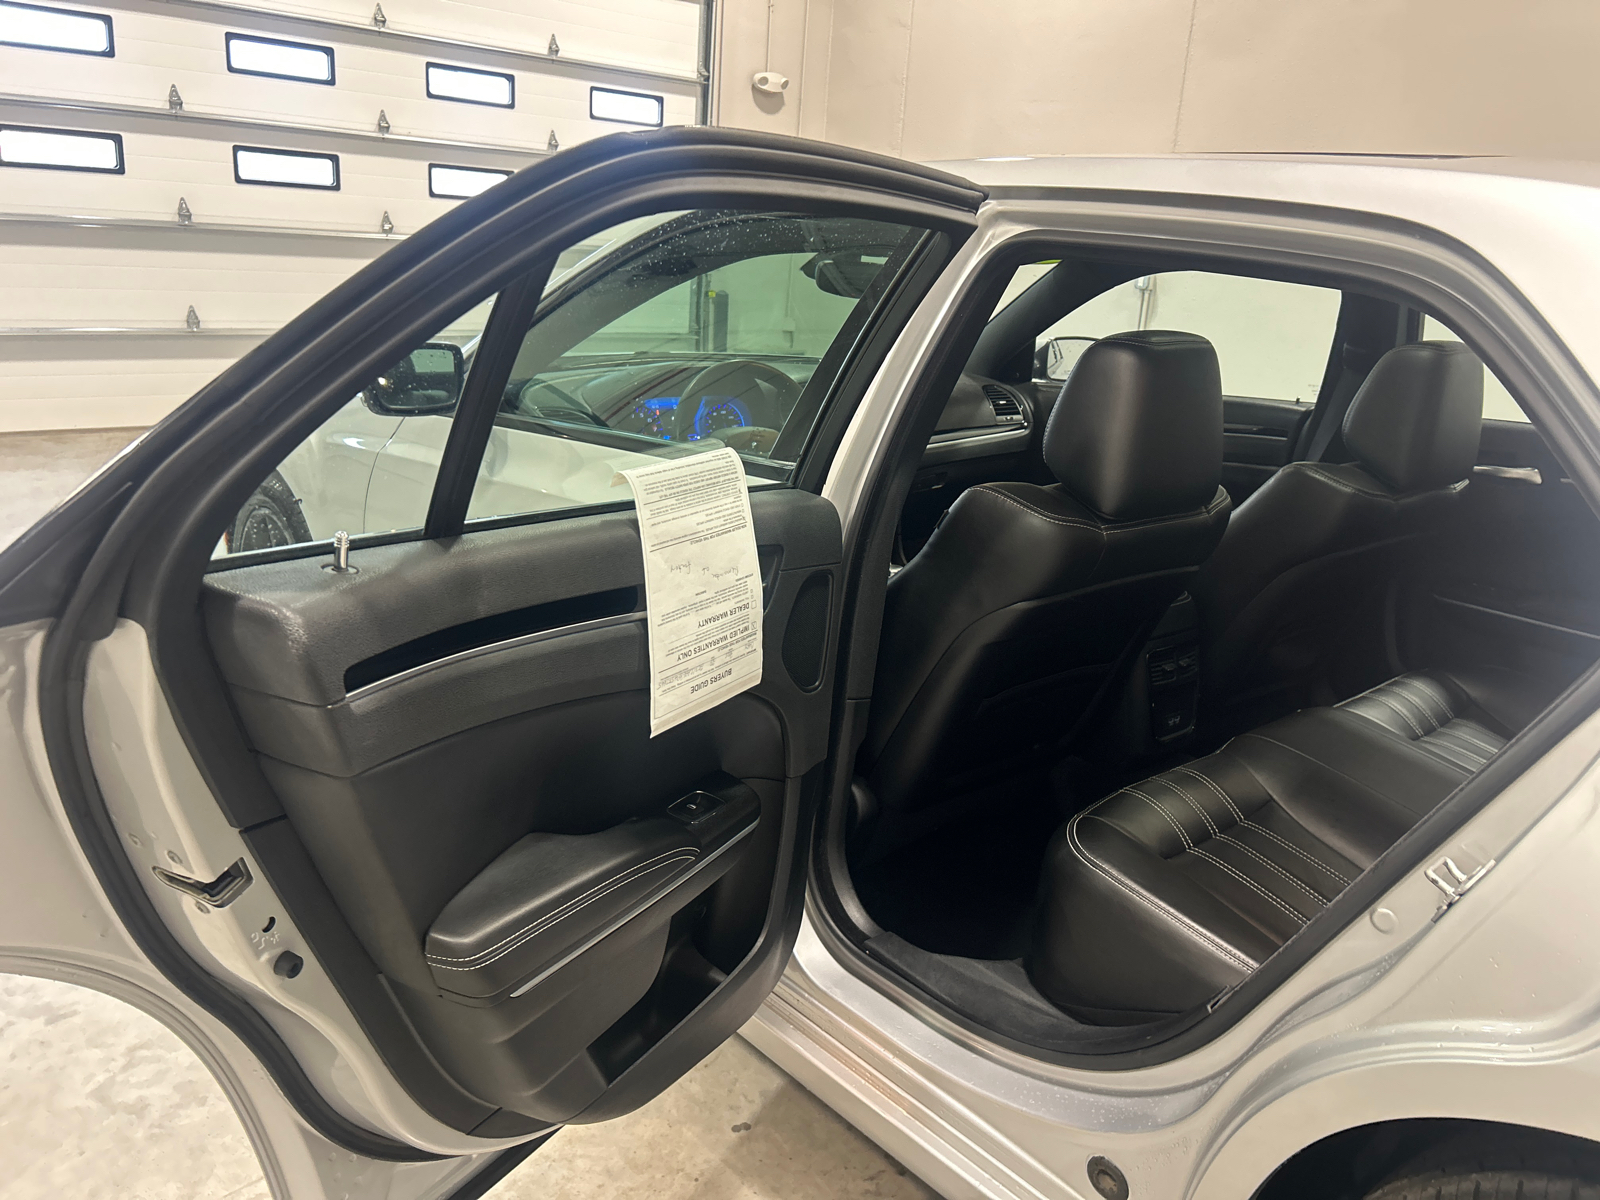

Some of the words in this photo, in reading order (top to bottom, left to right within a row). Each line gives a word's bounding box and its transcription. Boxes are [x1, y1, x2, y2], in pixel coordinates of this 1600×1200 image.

[729, 602, 750, 614] DEALER
[698, 610, 729, 628] WARRANTY
[729, 625, 750, 639] IMPLIED
[693, 635, 728, 655] WARRANTIES
[677, 649, 692, 662] ONLY
[709, 668, 732, 685] BUYERS
[690, 680, 709, 694] GUIDE
